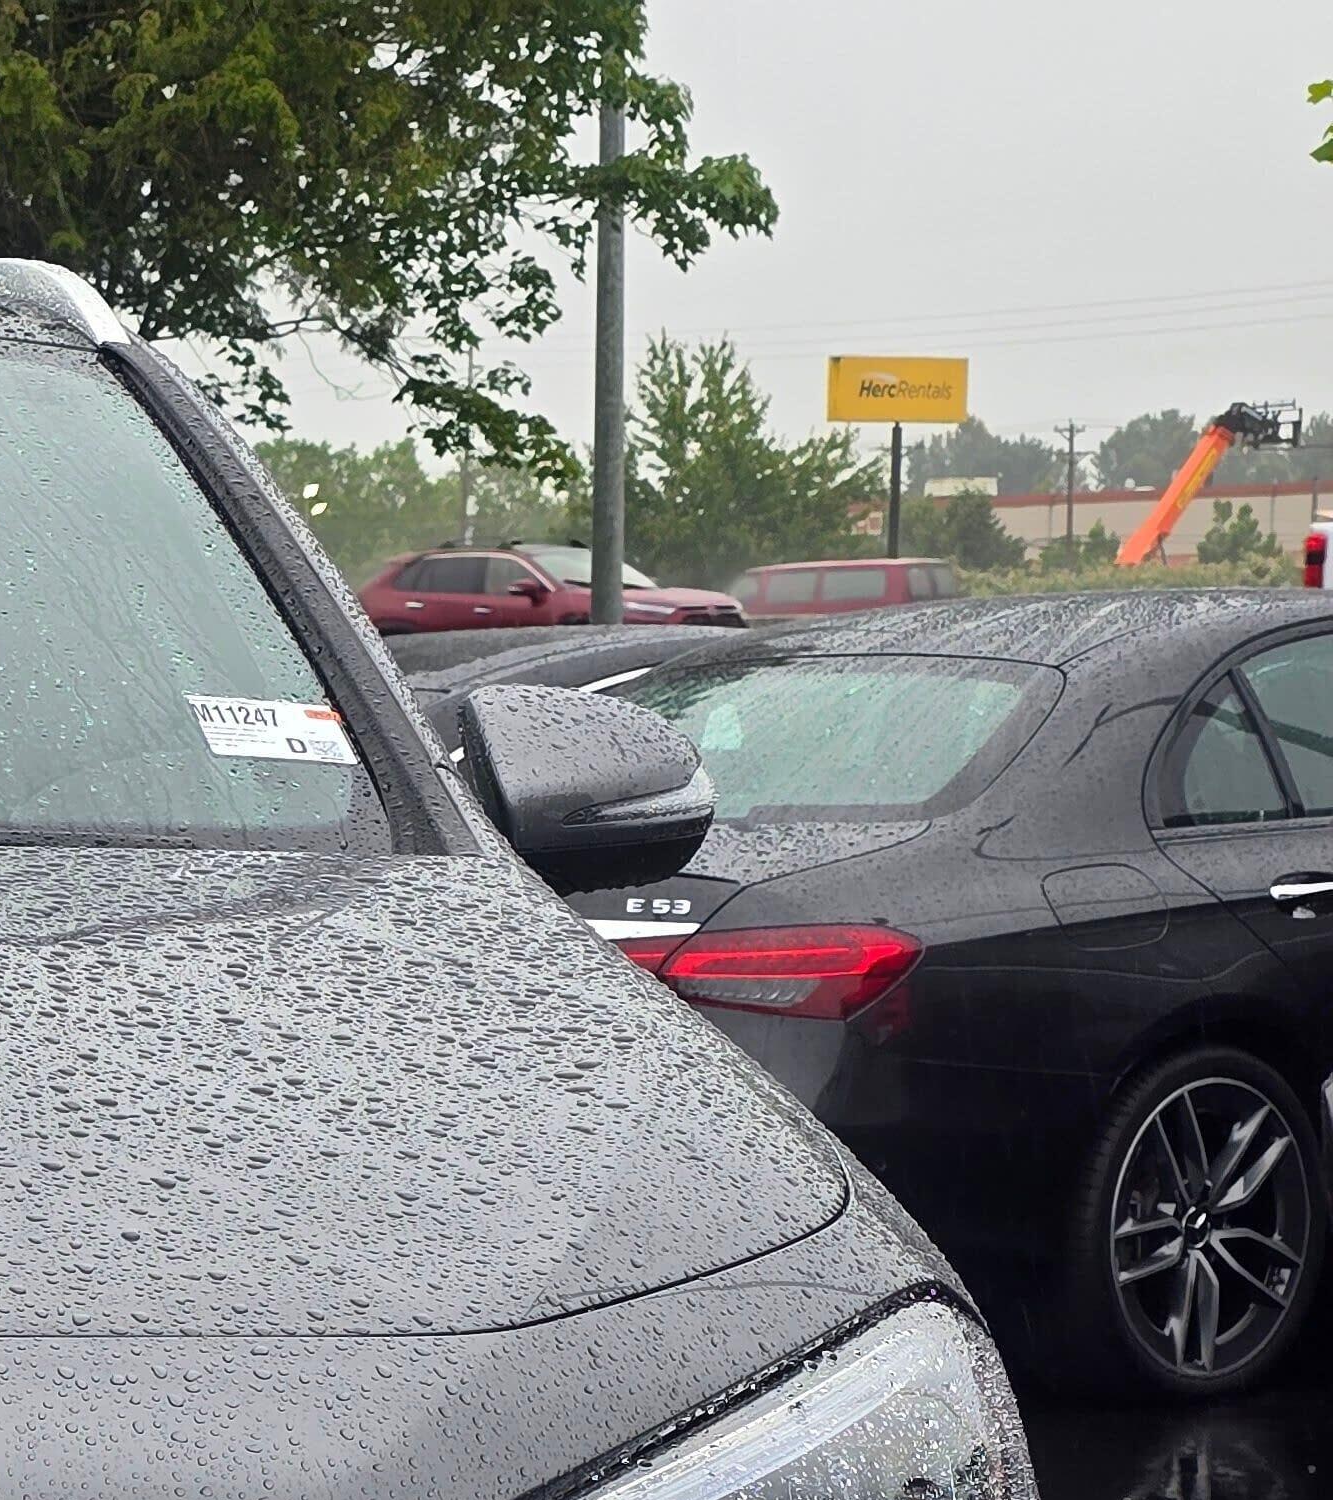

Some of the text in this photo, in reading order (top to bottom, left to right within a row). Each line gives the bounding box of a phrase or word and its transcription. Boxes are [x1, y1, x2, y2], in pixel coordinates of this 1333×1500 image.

[192, 703, 278, 727] M11247
[285, 737, 308, 754] D
[626, 898, 692, 915] E 53
